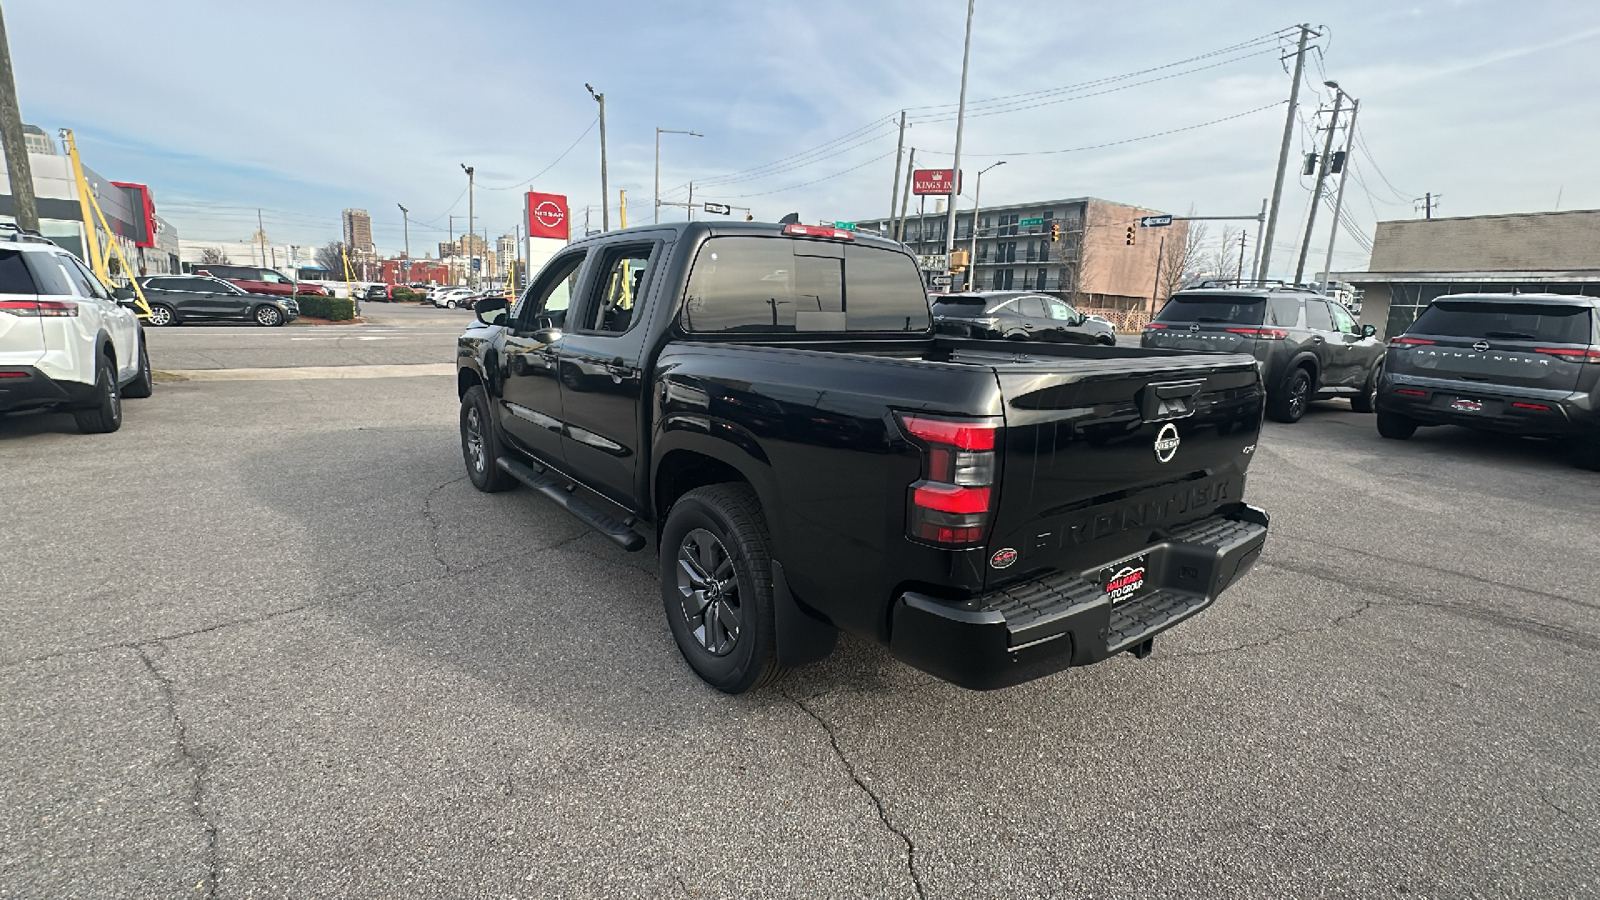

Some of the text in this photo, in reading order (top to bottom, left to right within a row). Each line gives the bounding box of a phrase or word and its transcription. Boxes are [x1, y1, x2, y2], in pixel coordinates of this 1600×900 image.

[916, 181, 941, 189] KINGS
[534, 210, 564, 218] NISSAN
[1417, 350, 1549, 366] PATHFINDER
[1155, 438, 1180, 450] NISSAN
[1023, 480, 1229, 560] FRONTIER
[1106, 571, 1142, 592] HALLMARK
[1122, 580, 1144, 594] GROUP
